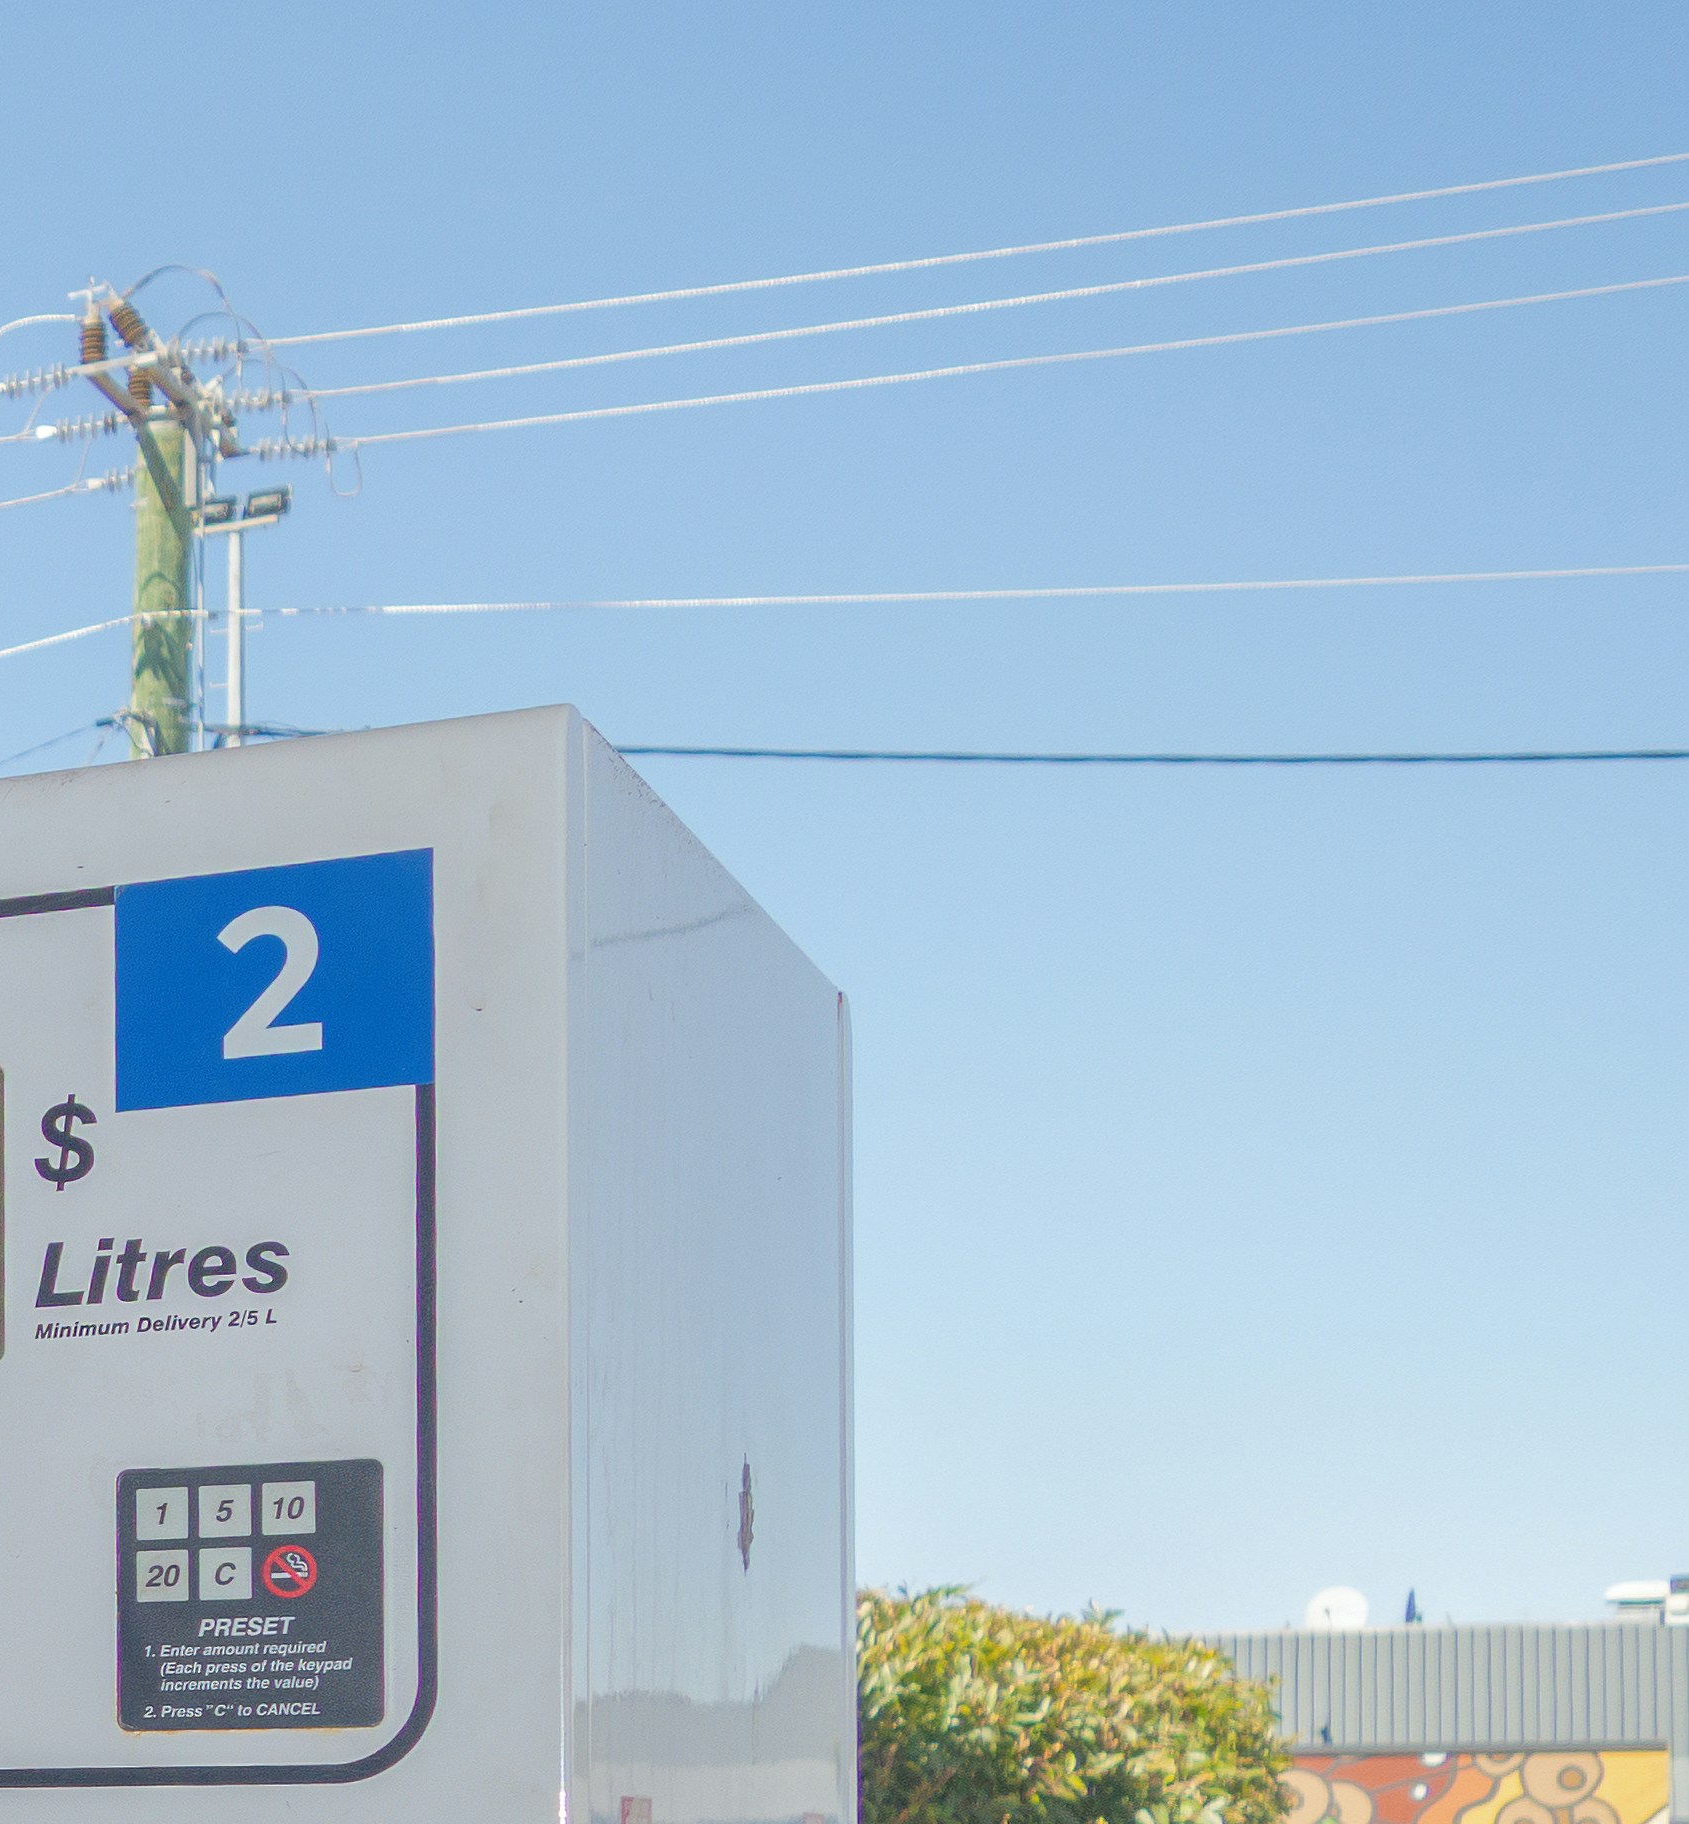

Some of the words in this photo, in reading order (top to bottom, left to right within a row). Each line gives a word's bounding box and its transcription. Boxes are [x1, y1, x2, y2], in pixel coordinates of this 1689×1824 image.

[217, 905, 323, 1060] 2
[34, 1094, 98, 1192] $
[35, 1237, 290, 1308] Litres
[35, 1319, 130, 1340] Minimum
[136, 1313, 223, 1337] Delivery
[228, 1310, 260, 1329] 2/5
[265, 1309, 277, 1325] L
[156, 1503, 168, 1525] 1
[216, 1499, 234, 1522] 5
[273, 1496, 304, 1520] 10
[146, 1565, 180, 1588] 20
[214, 1562, 236, 1585] C
[198, 1616, 296, 1637] PRESET
[145, 1645, 156, 1658] 1.
[160, 1645, 200, 1657] Enter
[203, 1643, 261, 1656] amount
[263, 1641, 327, 1656] required
[160, 1662, 202, 1677] (Each
[205, 1661, 247, 1675] press
[251, 1660, 267, 1672] of
[271, 1660, 294, 1672] the
[298, 1658, 353, 1673] keypad
[160, 1679, 243, 1692] increments
[246, 1678, 270, 1690] the
[274, 1675, 320, 1691] value)
